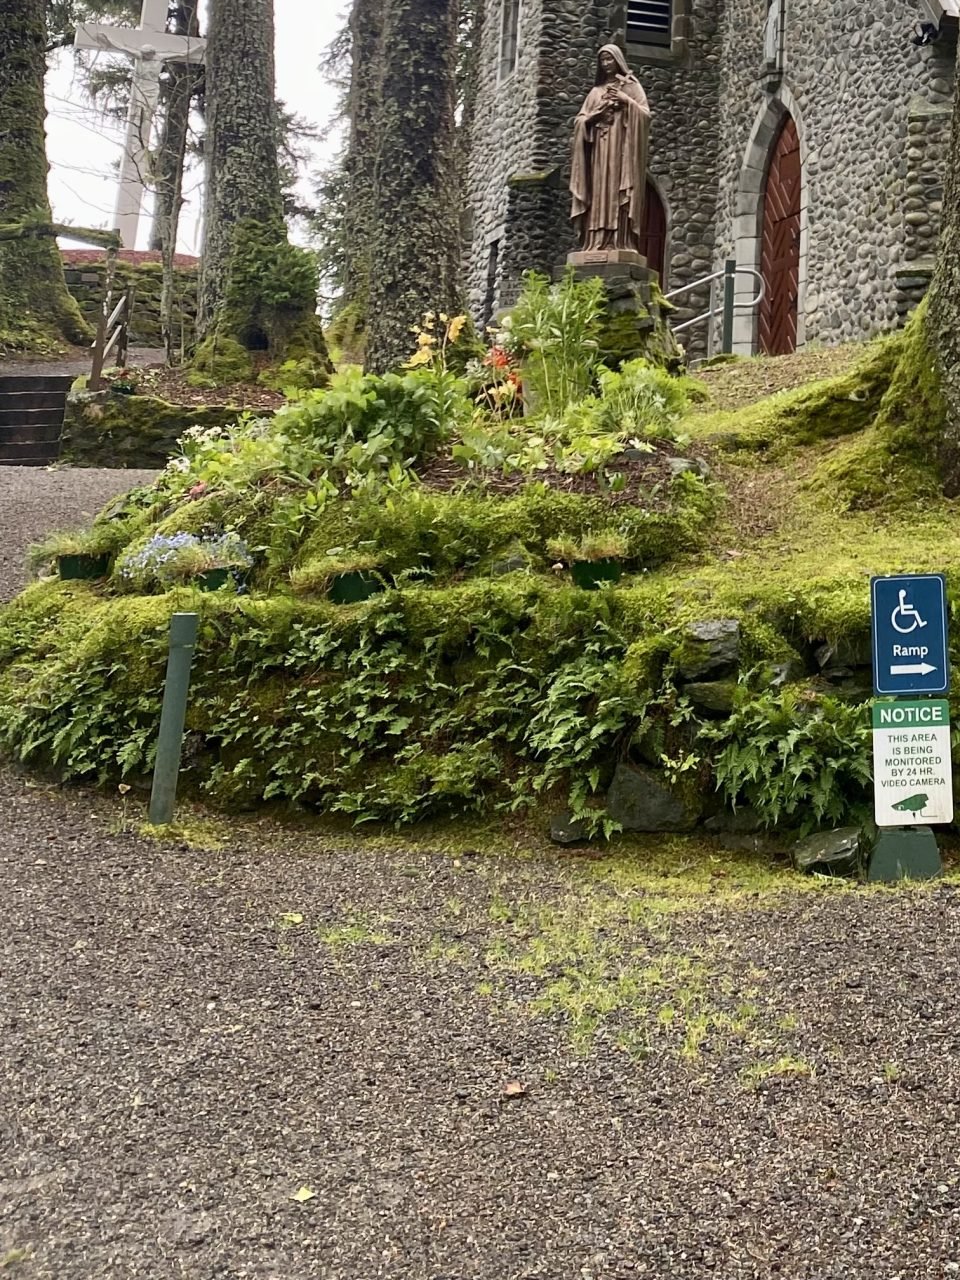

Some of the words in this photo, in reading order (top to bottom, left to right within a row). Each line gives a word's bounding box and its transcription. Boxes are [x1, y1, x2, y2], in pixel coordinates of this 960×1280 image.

[893, 644, 928, 659] Ramp
[880, 706, 943, 723] NOTICE
[888, 734, 909, 743] THIS
[911, 733, 937, 742] AREA
[892, 747, 901, 756] IS
[903, 745, 933, 755] BEING
[885, 756, 942, 767] MONITORED
[891, 768, 904, 777] BY
[906, 767, 917, 776] 24
[881, 779, 907, 788] VIDEO
[909, 777, 946, 787] CAMERA
